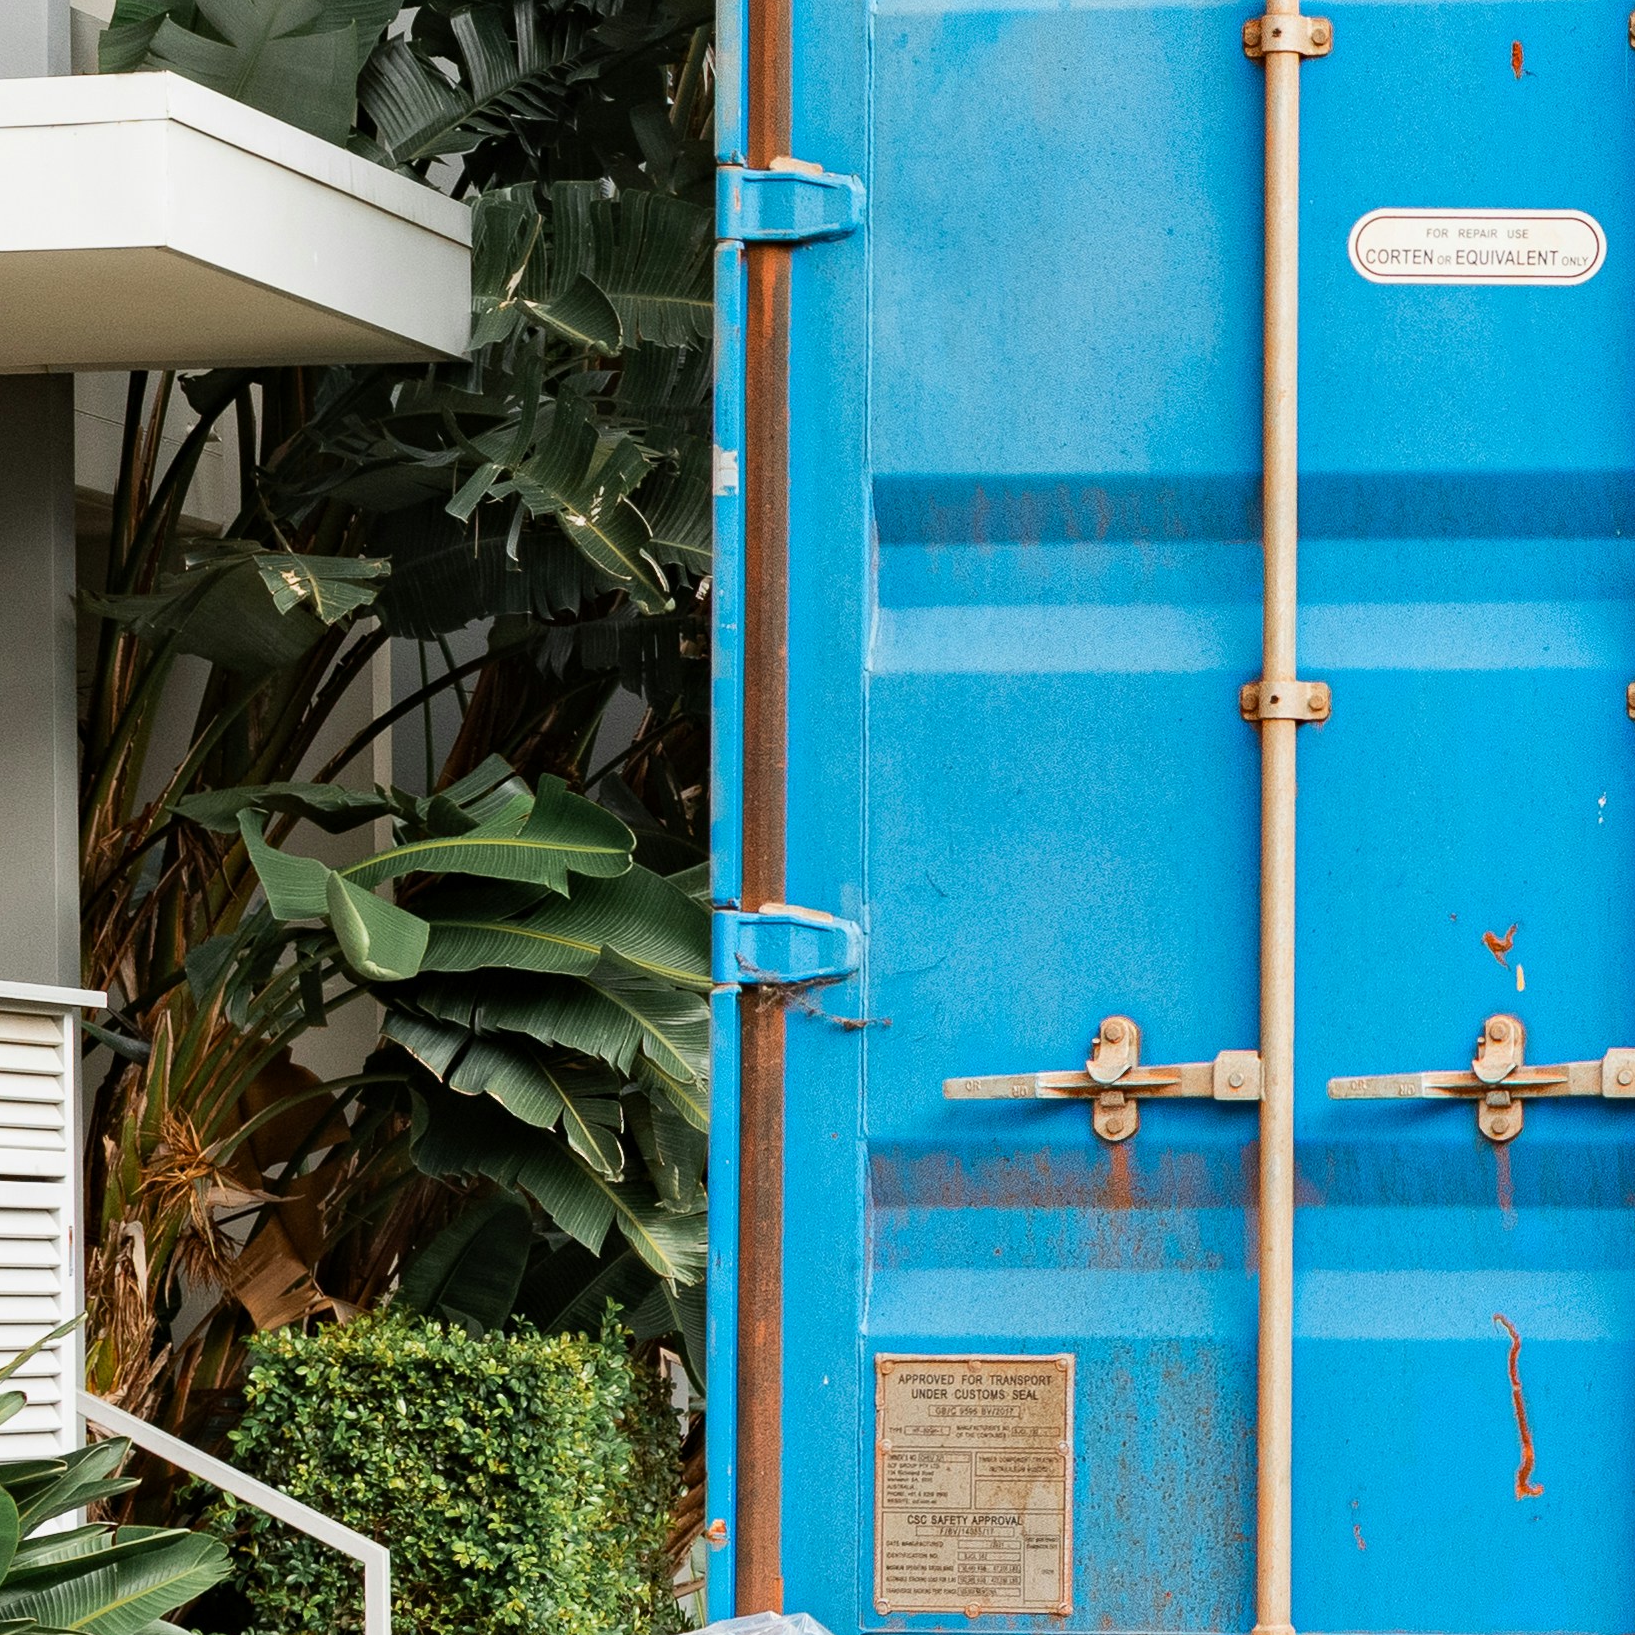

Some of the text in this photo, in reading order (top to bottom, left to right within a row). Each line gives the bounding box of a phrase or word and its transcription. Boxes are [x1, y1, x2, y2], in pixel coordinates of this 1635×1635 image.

[1426, 228, 1530, 239] FOR REPAIR USE
[1366, 248, 1590, 268] CORTEN OR EQUIVALENT ONLY
[898, 1374, 1053, 1386] APPROVED FOR TRANSPORT
[911, 1389, 1039, 1401] UNDER CUSTOMS SEAL
[907, 1515, 1023, 1526] CSC SAFETY APPROVAL
